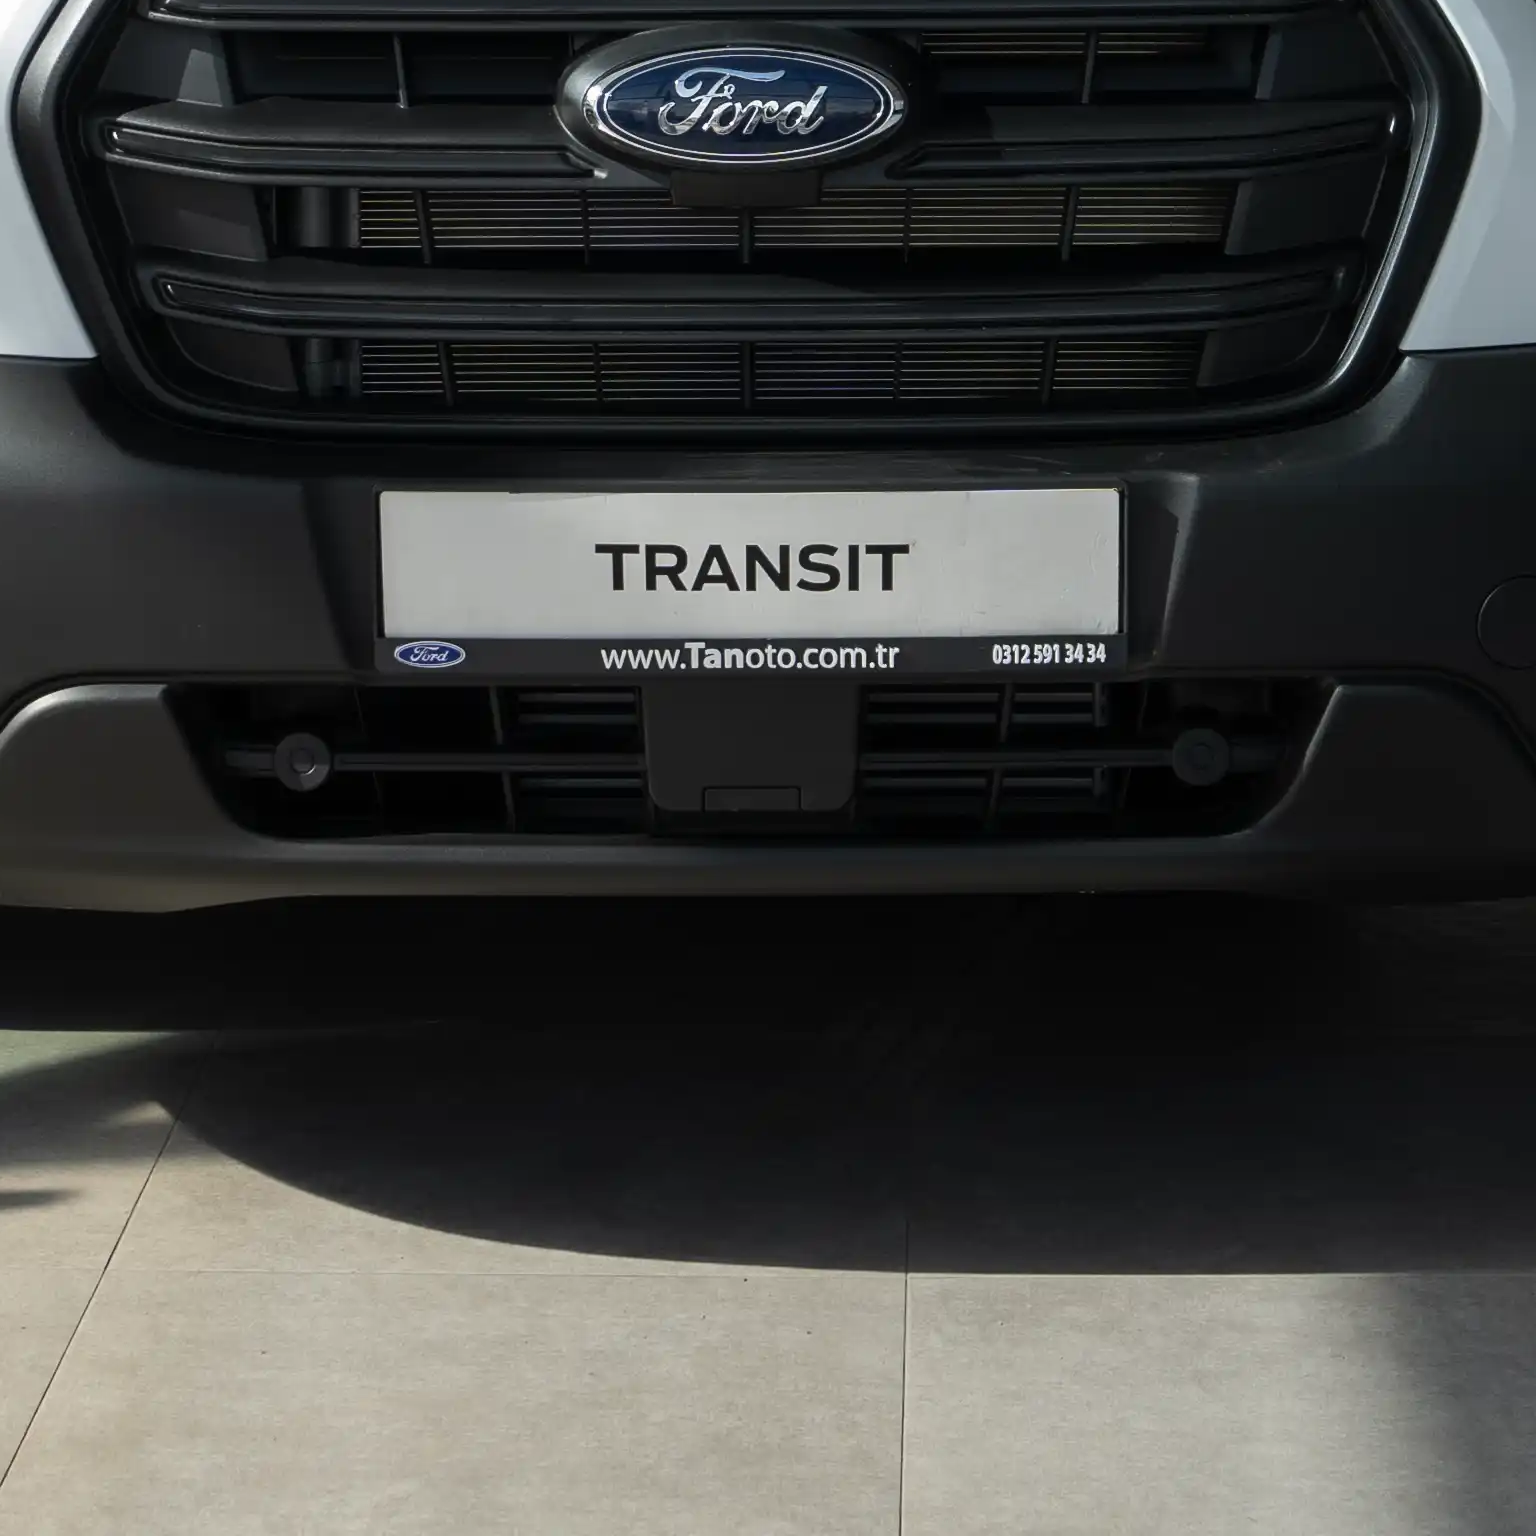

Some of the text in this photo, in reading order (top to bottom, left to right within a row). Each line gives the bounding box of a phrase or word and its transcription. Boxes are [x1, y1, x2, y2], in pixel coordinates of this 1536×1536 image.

[657, 66, 829, 136] Ford
[594, 543, 911, 592] TRANSIT
[409, 645, 450, 663] Ford
[600, 641, 900, 670] www.Tanoto.com.tr
[992, 643, 1107, 664] 0312 591 34 34
